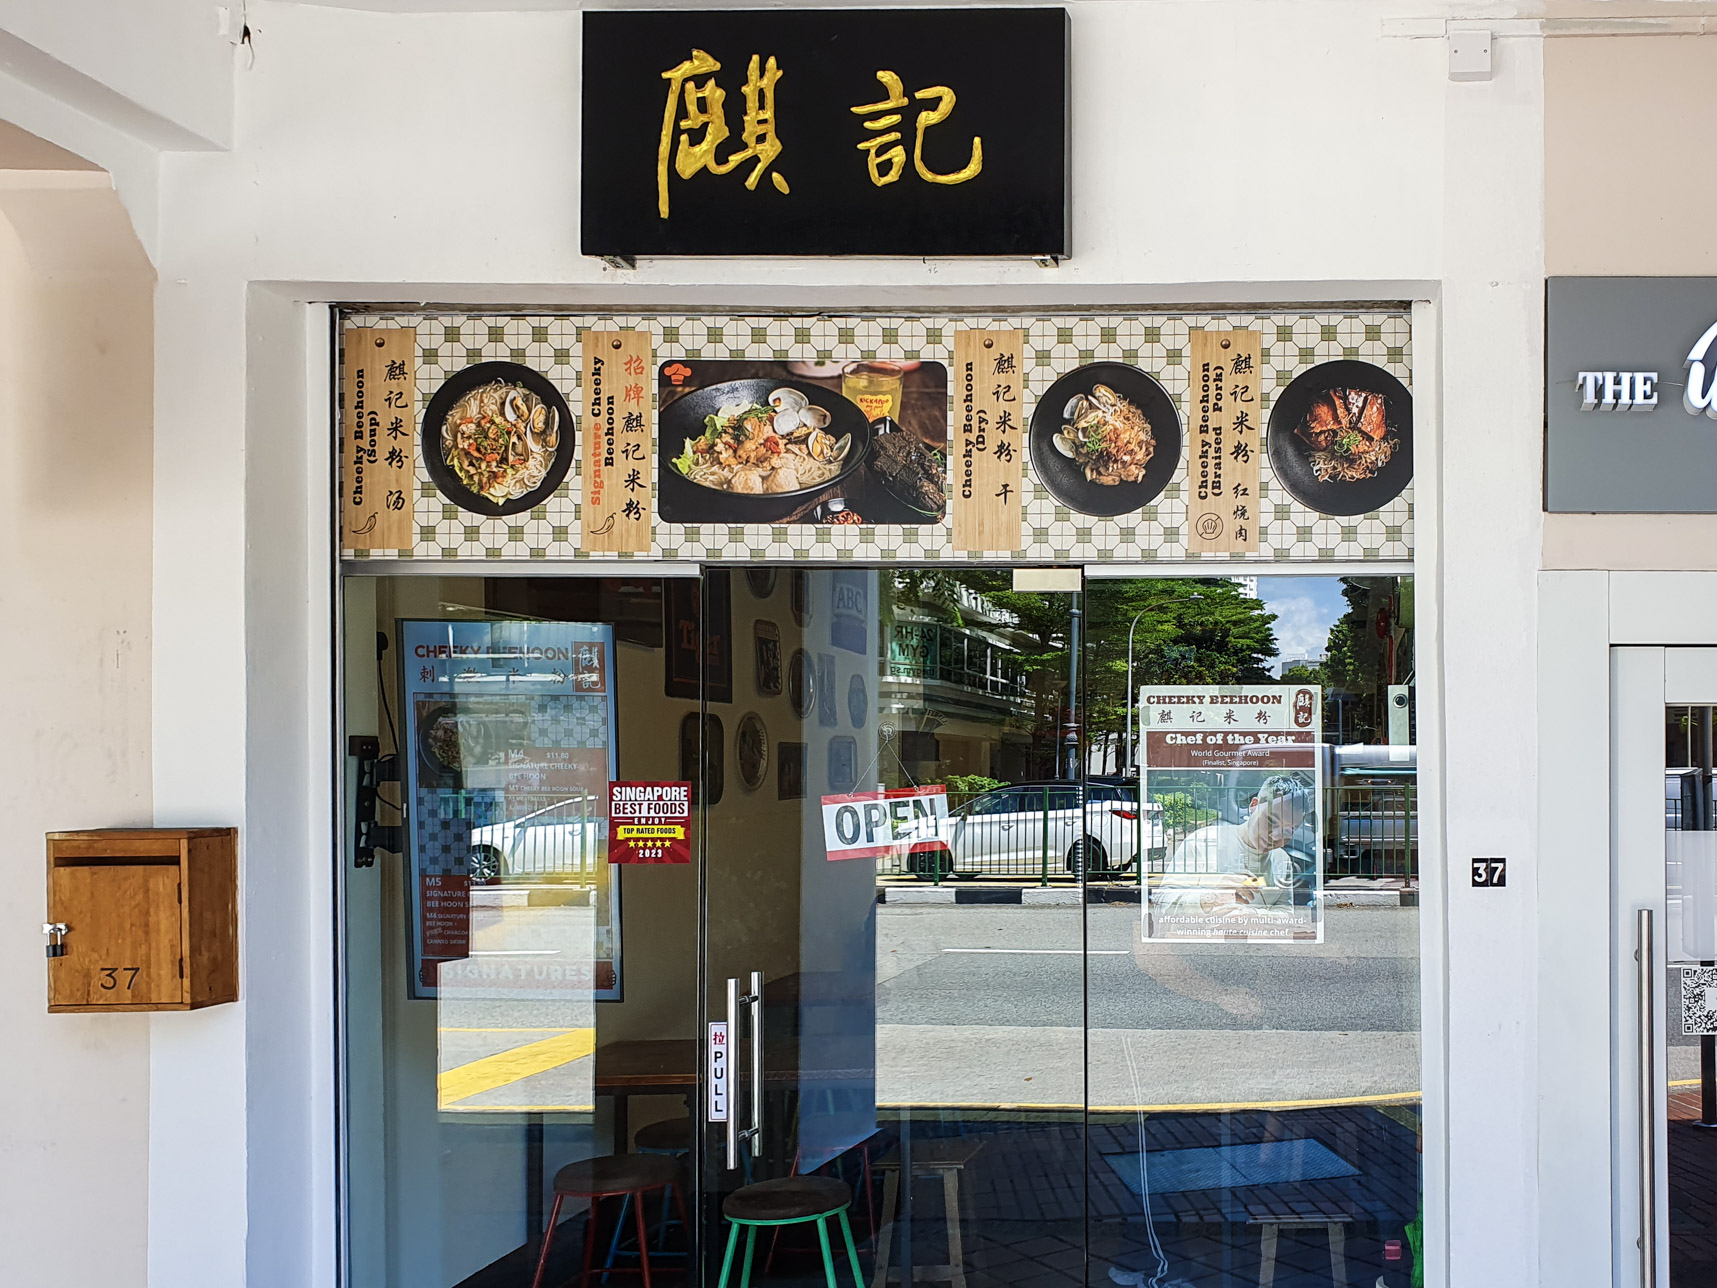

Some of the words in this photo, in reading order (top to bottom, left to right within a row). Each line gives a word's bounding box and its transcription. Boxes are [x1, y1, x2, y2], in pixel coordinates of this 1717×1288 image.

[591, 356, 604, 418] Cheeky
[963, 361, 973, 434] Beehoon
[1199, 362, 1210, 434] Beehoon
[1212, 365, 1224, 413] Pork)
[1576, 371, 1658, 408] THE
[354, 368, 364, 440] Beehoon
[367, 410, 380, 464] (Soup)
[604, 395, 615, 467] Beehoon
[976, 409, 988, 453] (Dry)
[591, 422, 604, 506] Signature
[962, 438, 976, 499] Cheeky
[1198, 438, 1212, 500] Cheeky
[1211, 425, 1223, 497] (Braised
[353, 444, 366, 506] Cheeky
[386, 489, 406, 511] 汤
[995, 483, 1014, 506] 干
[837, 586, 862, 613] ABC
[1146, 695, 1206, 705] CHEEKY
[1208, 694, 1283, 705] BEEHOON
[1165, 733, 1204, 745] Chef
[1206, 733, 1223, 745] of
[1226, 733, 1254, 745] the
[1256, 733, 1296, 745] Year
[1191, 749, 1212, 757] World
[1227, 759, 1259, 768] Singapore)
[612, 786, 688, 801] SINGAPORE
[614, 802, 643, 815] BEST
[647, 802, 685, 815] FOODS
[634, 817, 666, 825] ENJOY
[834, 797, 939, 846] OPEN
[638, 849, 662, 858] 2023
[1473, 862, 1504, 884] 37
[1158, 915, 1203, 924] affordable
[1205, 915, 1236, 924] cuisine
[1238, 915, 1248, 926] by
[1176, 928, 1211, 937] winning
[99, 967, 141, 991] 37
[443, 964, 593, 982] SIGNATURES
[713, 1031, 725, 1045] 拉
[714, 1050, 724, 1112] PULL
